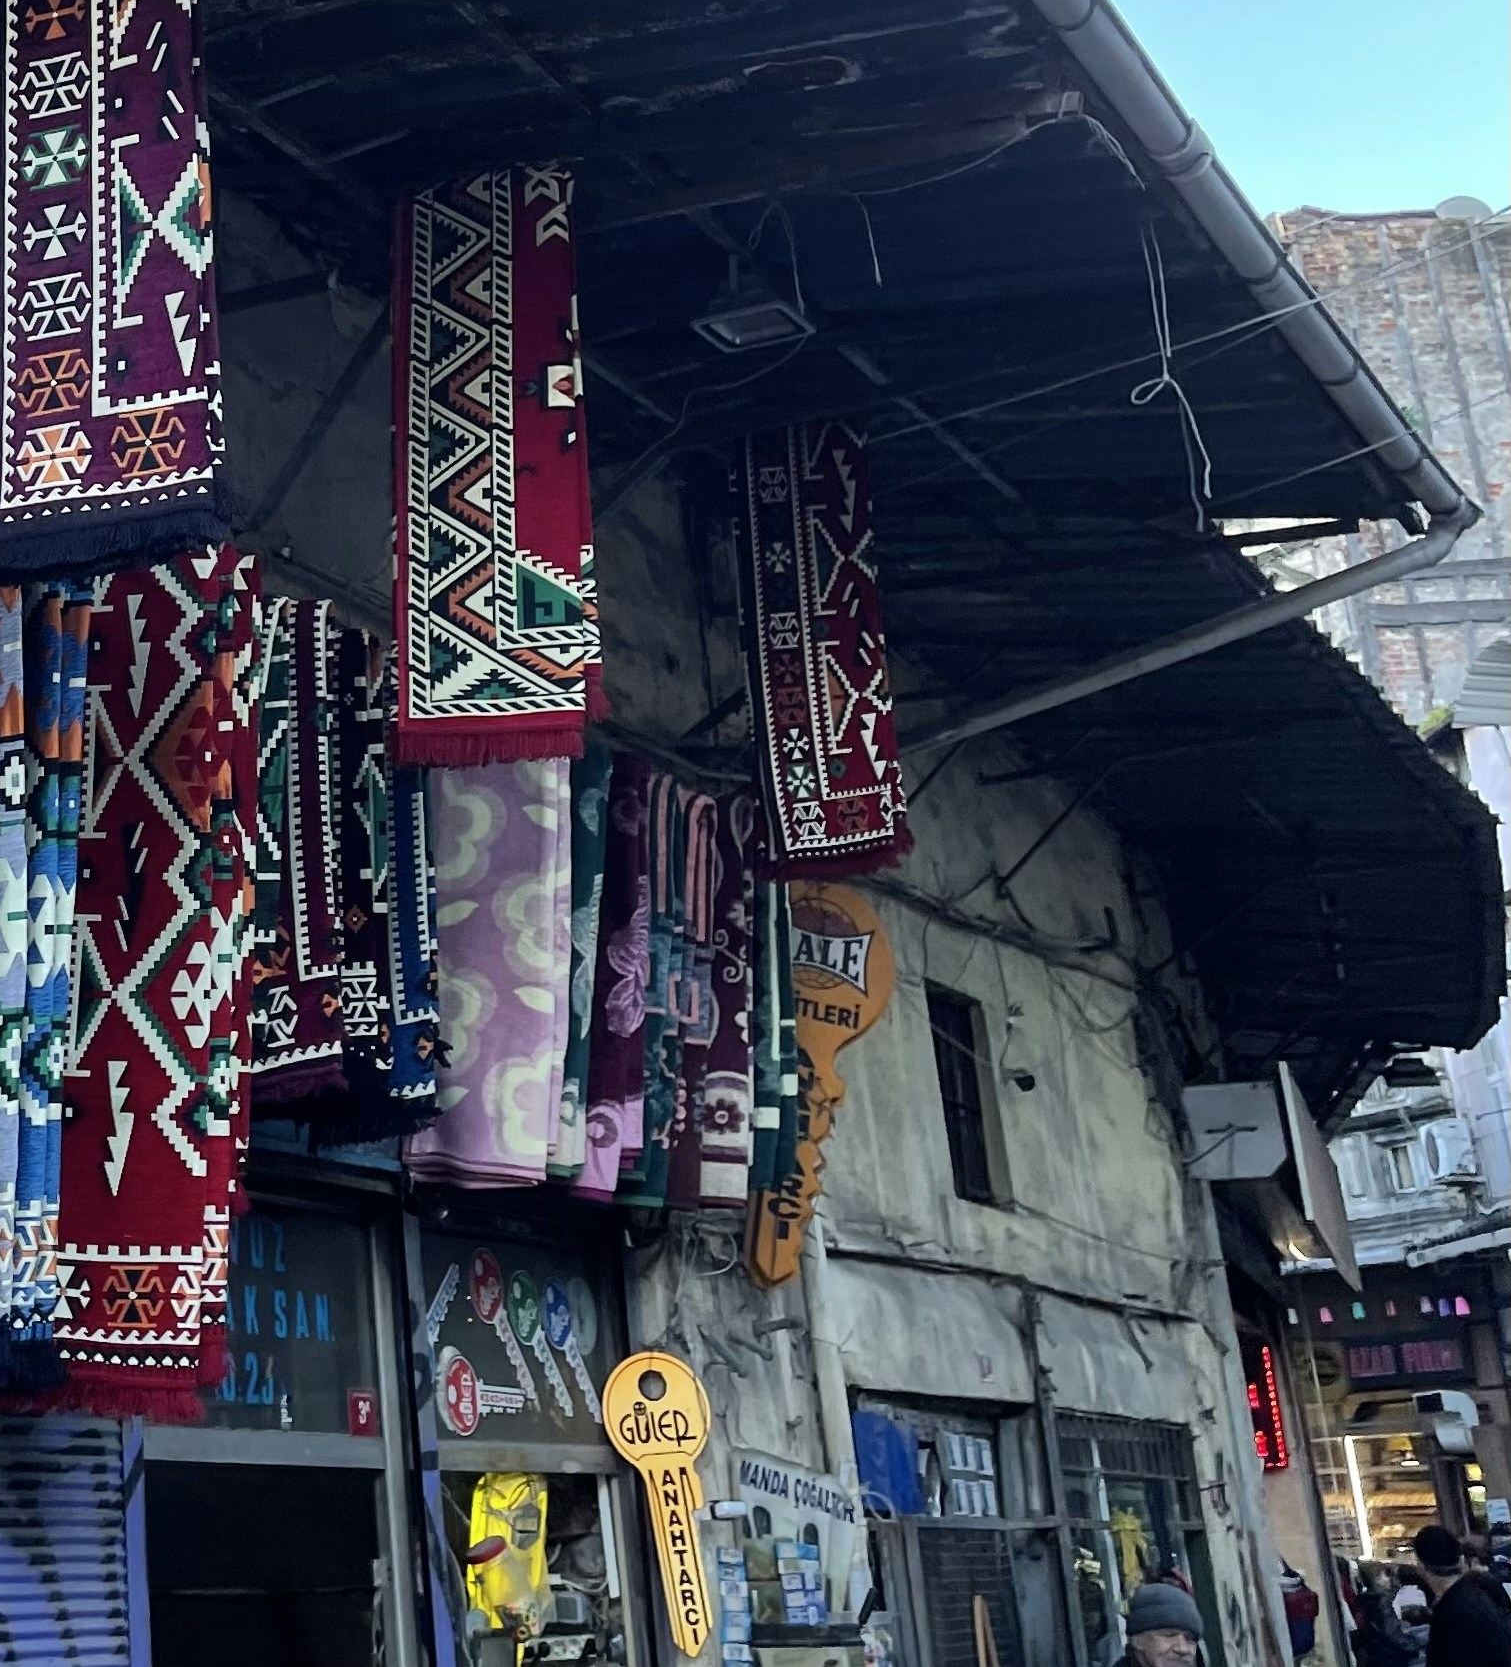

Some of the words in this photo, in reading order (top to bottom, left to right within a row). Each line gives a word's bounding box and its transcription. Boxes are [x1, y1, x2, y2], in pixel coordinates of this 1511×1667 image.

[793, 933, 863, 983] ALE
[795, 990, 861, 1030] İTLERİ
[661, 1469, 700, 1646] ANAHTARCI
